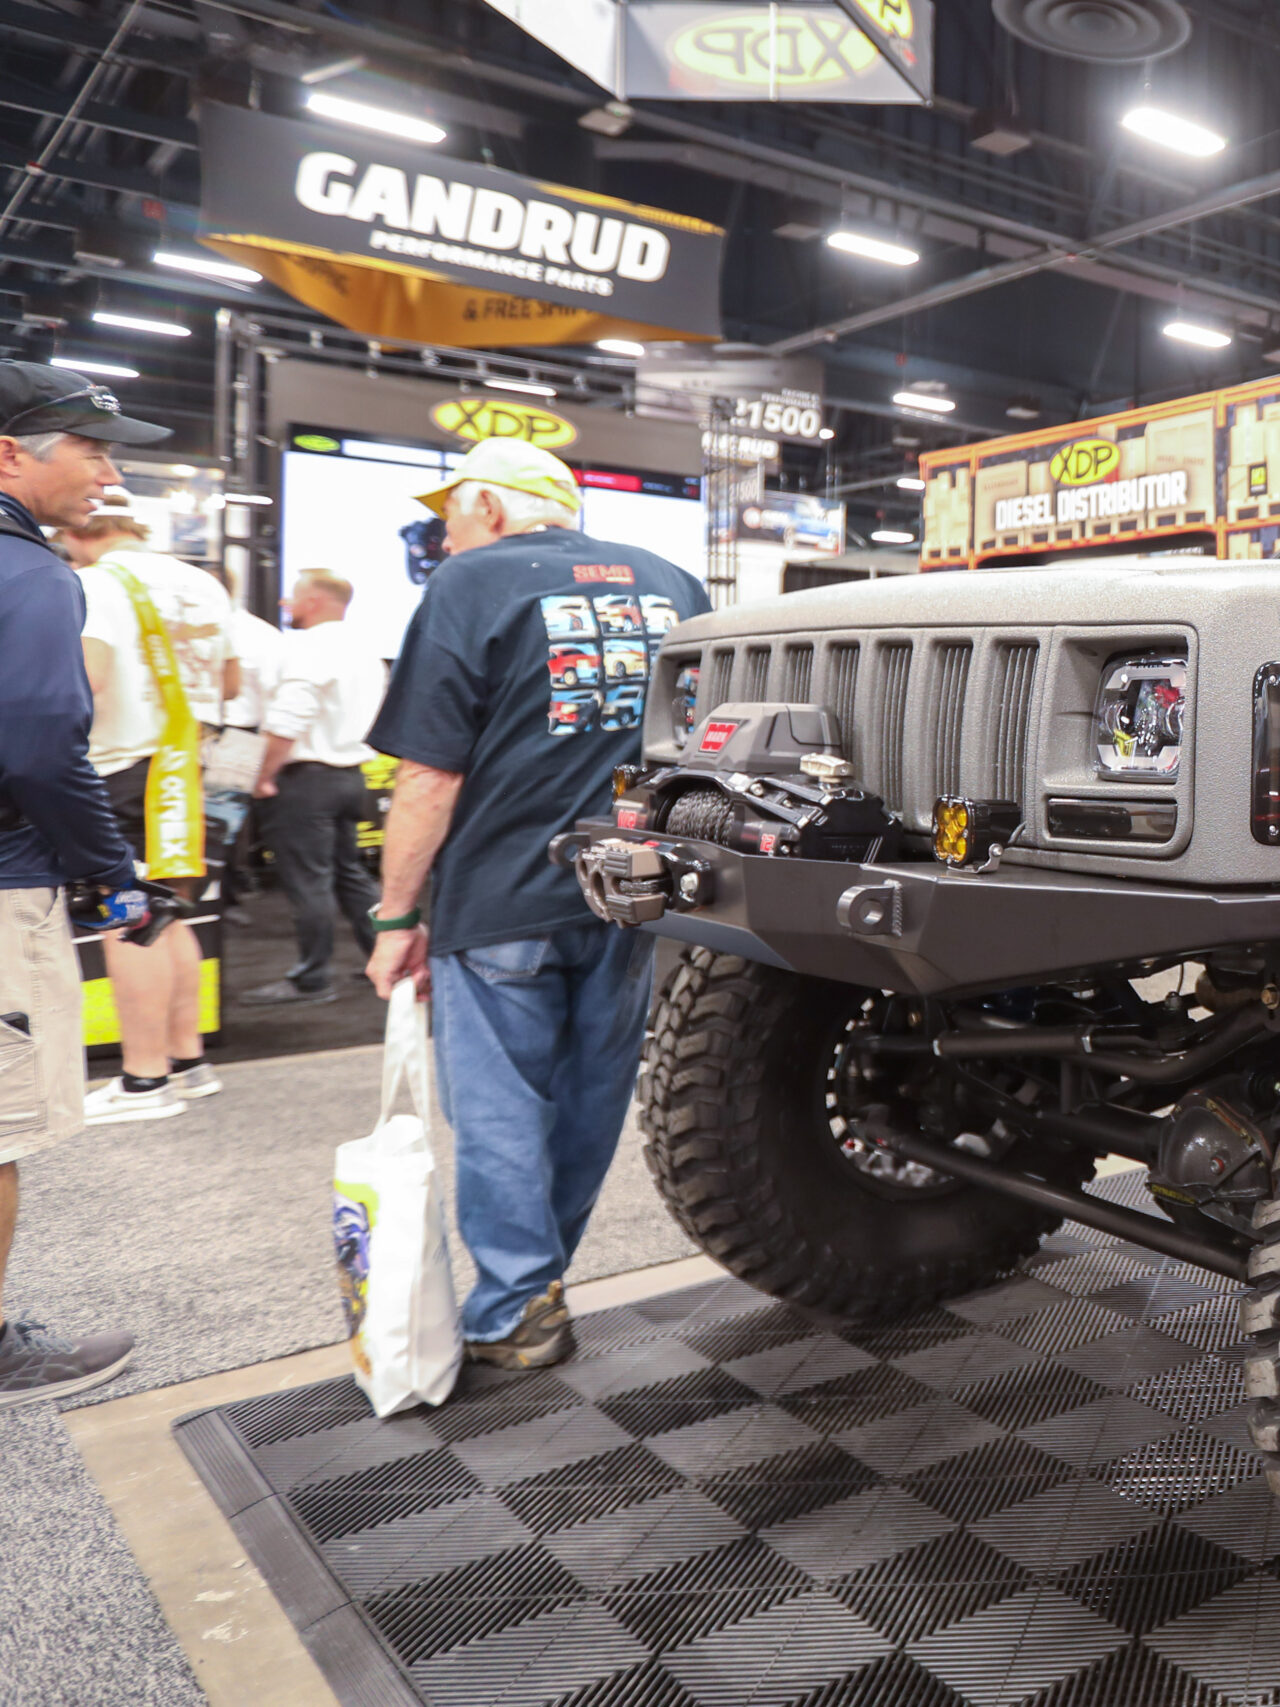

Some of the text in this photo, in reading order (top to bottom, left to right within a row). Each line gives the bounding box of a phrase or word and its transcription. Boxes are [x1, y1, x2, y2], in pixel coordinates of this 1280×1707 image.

[295, 151, 670, 283] GANDRUD
[368, 229, 544, 283] PERFORMANCE
[545, 265, 614, 297] PARTS
[483, 298, 532, 319] FREE
[455, 401, 560, 442] XDP
[1057, 444, 1113, 482] XDP
[995, 470, 1187, 532] DIESEL DISTRIBUTOR
[760, 833, 775, 853] 12
